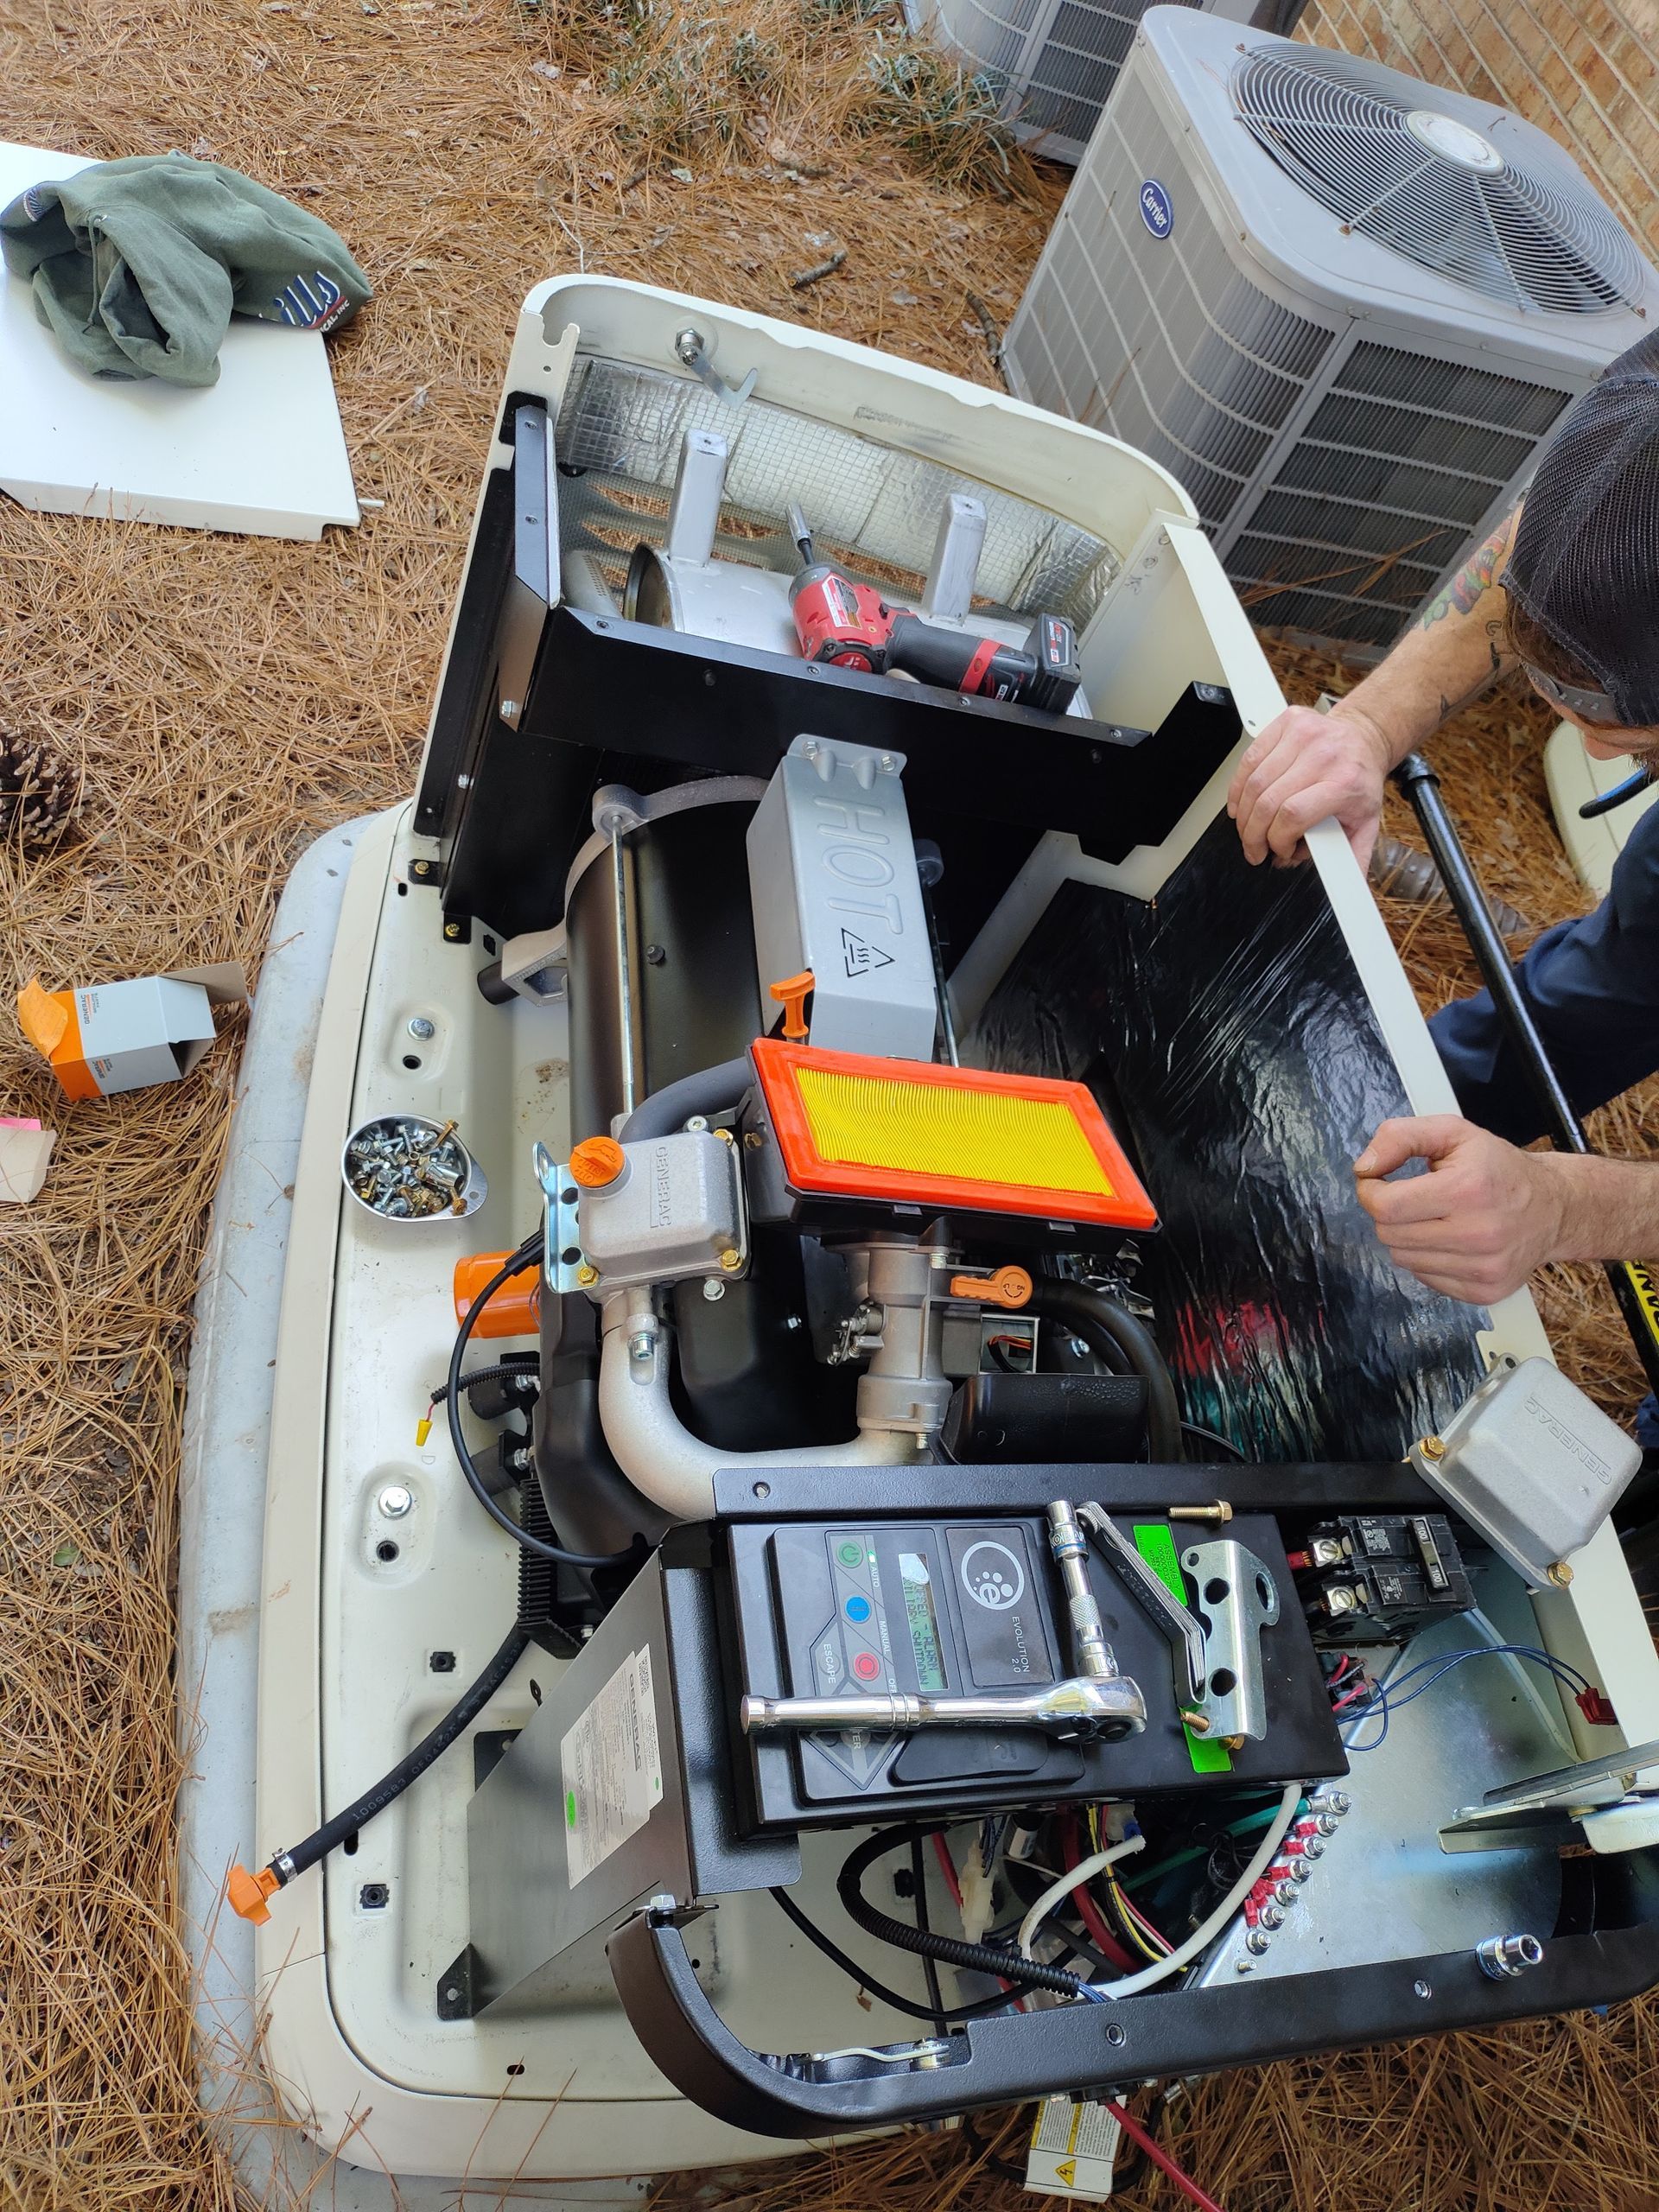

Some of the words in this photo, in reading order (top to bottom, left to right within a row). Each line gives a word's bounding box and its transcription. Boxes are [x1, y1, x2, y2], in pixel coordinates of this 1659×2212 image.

[1142, 188, 1167, 228] Carrier
[813, 795, 904, 935] HOT
[655, 1146, 672, 1227] GENERAC
[1523, 1399, 1612, 1485] GENERAC
[1418, 1528, 1428, 1540] 100
[870, 1567, 880, 1588] AUTO
[1163, 1544, 1181, 1590] ASSEMBLY
[1432, 1569, 1442, 1583] 100
[879, 1620, 891, 1655] MANUAL
[911, 1630, 930, 1686] SHUTDOWN
[923, 1636, 939, 1671] ALARM
[1012, 1616, 1030, 1673] EVOLUTION
[823, 1643, 836, 1685] ESCAPE
[1011, 1658, 1021, 1674] 2.0
[629, 1672, 642, 1770] GENERAC
[851, 1728, 861, 1751] TER
[352, 1777, 407, 1821] 1009583
